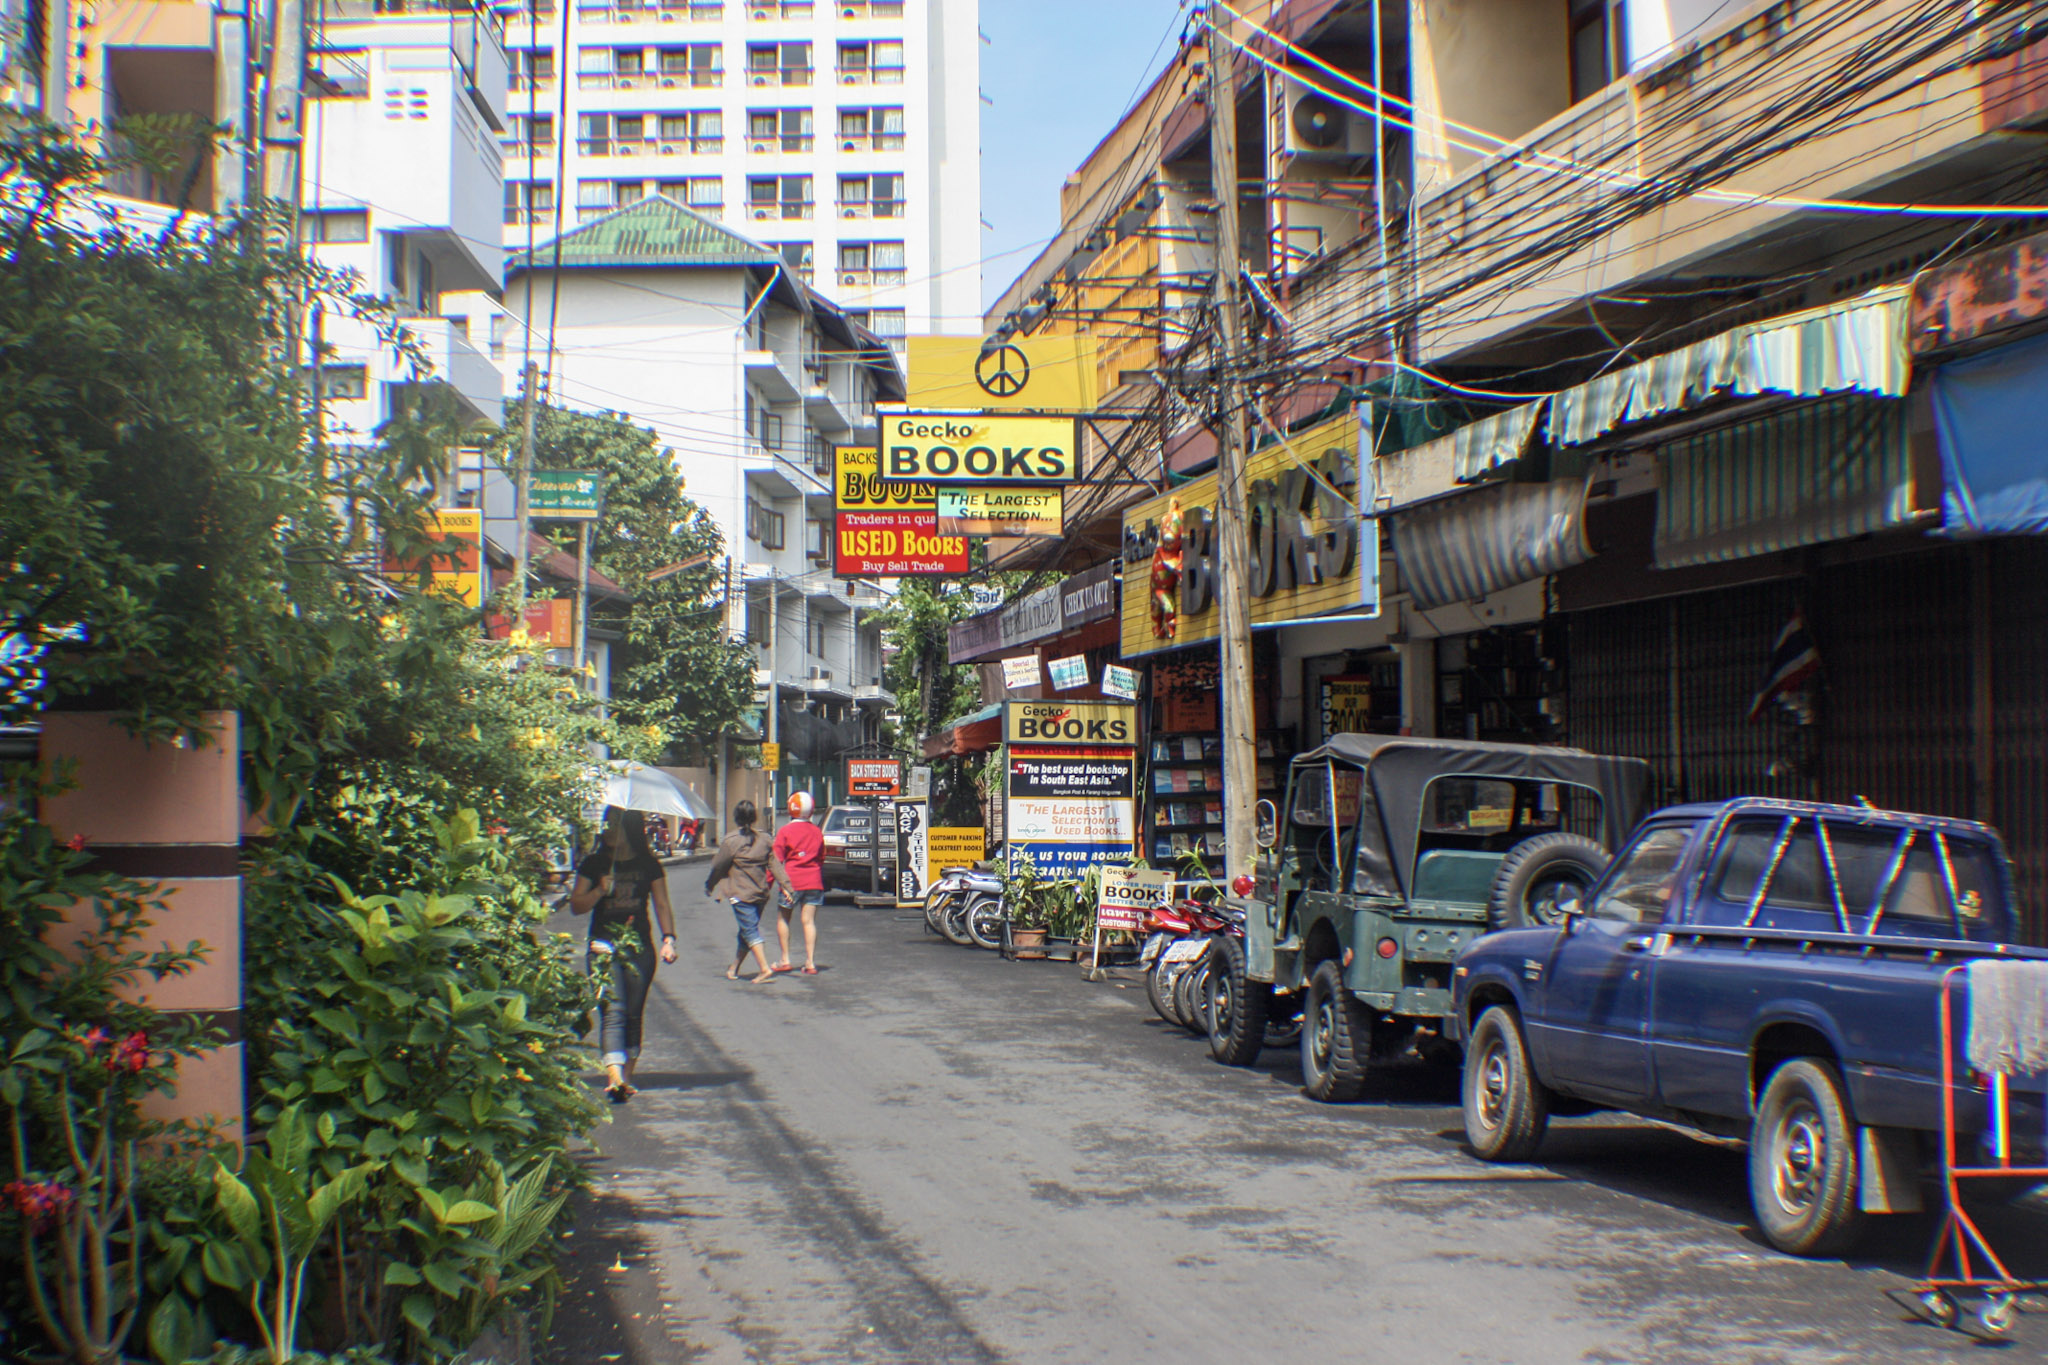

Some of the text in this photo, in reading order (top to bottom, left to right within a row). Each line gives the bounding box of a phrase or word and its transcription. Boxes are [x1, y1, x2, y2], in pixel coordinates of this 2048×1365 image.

[897, 420, 973, 438] Gecko
[890, 446, 1065, 477] BOOKS
[444, 516, 473, 526] BOOKS
[845, 514, 894, 524] Traders
[898, 514, 911, 524] in
[1181, 448, 1359, 615] BOKS
[841, 530, 897, 556] USED
[862, 561, 944, 572] Buy Sell Trade
[1064, 580, 1109, 617] CHECK US OUT
[1022, 706, 1063, 716] Gecko
[1019, 718, 1128, 740] BOOKS
[851, 764, 898, 778] BACK STREET BOOKS
[1041, 764, 1061, 774] best
[1063, 764, 1083, 774] used
[1085, 765, 1128, 776] bookshop
[1041, 775, 1066, 785] South
[1068, 776, 1088, 785] East
[850, 818, 866, 826] BUY
[899, 805, 912, 834] BACK
[1107, 817, 1120, 825] OF
[914, 832, 924, 871] STREET
[1039, 851, 1053, 861] US
[1057, 851, 1087, 861] YOUR
[1107, 868, 1133, 876] Gecko
[901, 871, 914, 899] BOOKS
[1100, 919, 1137, 929] CUSTOMER
